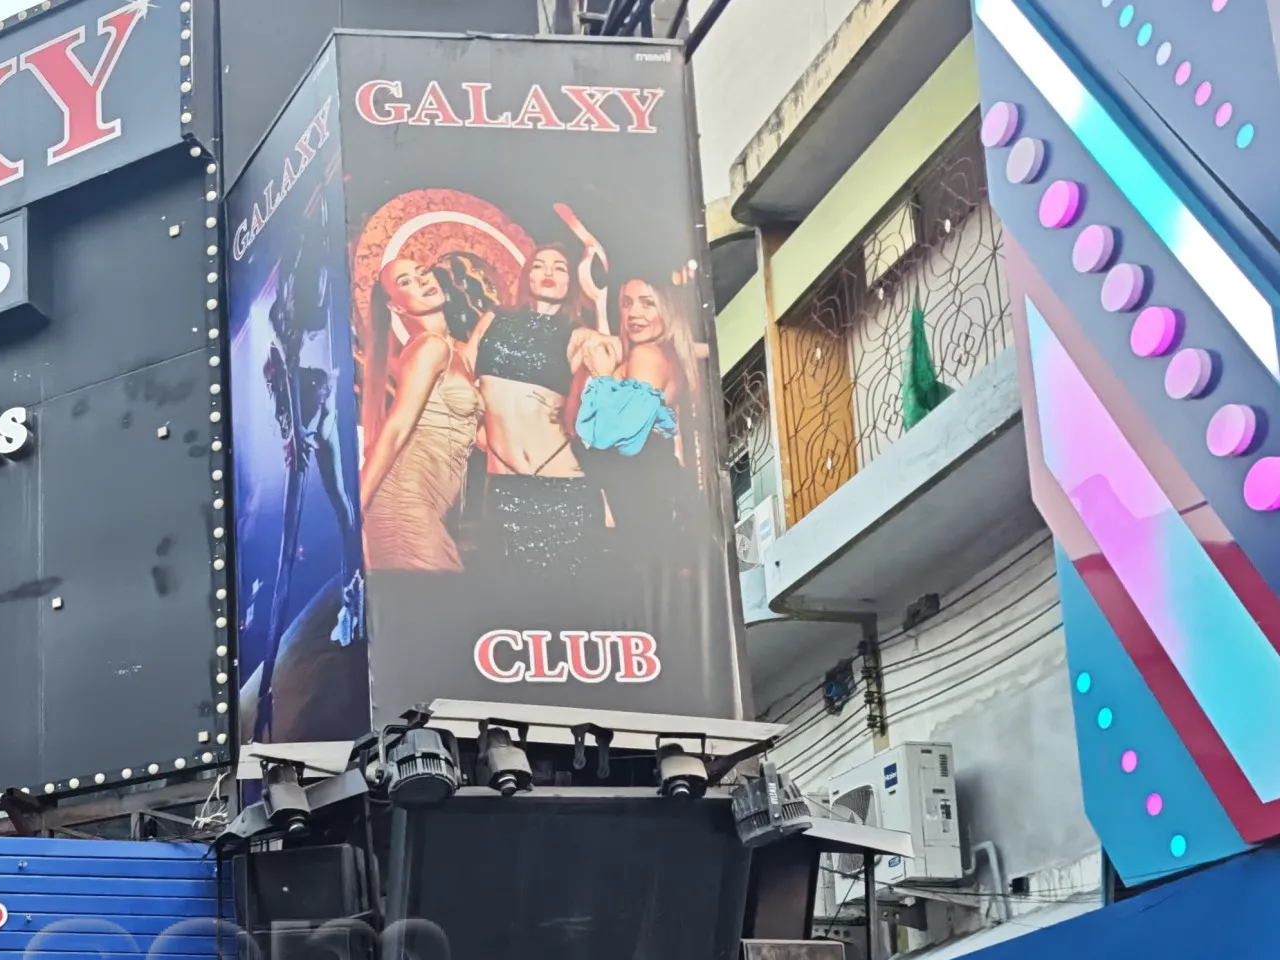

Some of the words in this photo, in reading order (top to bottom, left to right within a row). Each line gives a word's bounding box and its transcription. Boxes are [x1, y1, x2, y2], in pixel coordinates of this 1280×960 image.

[356, 80, 664, 134] GALAXY
[233, 95, 332, 261] GALAXY
[473, 629, 661, 683] CLUB
